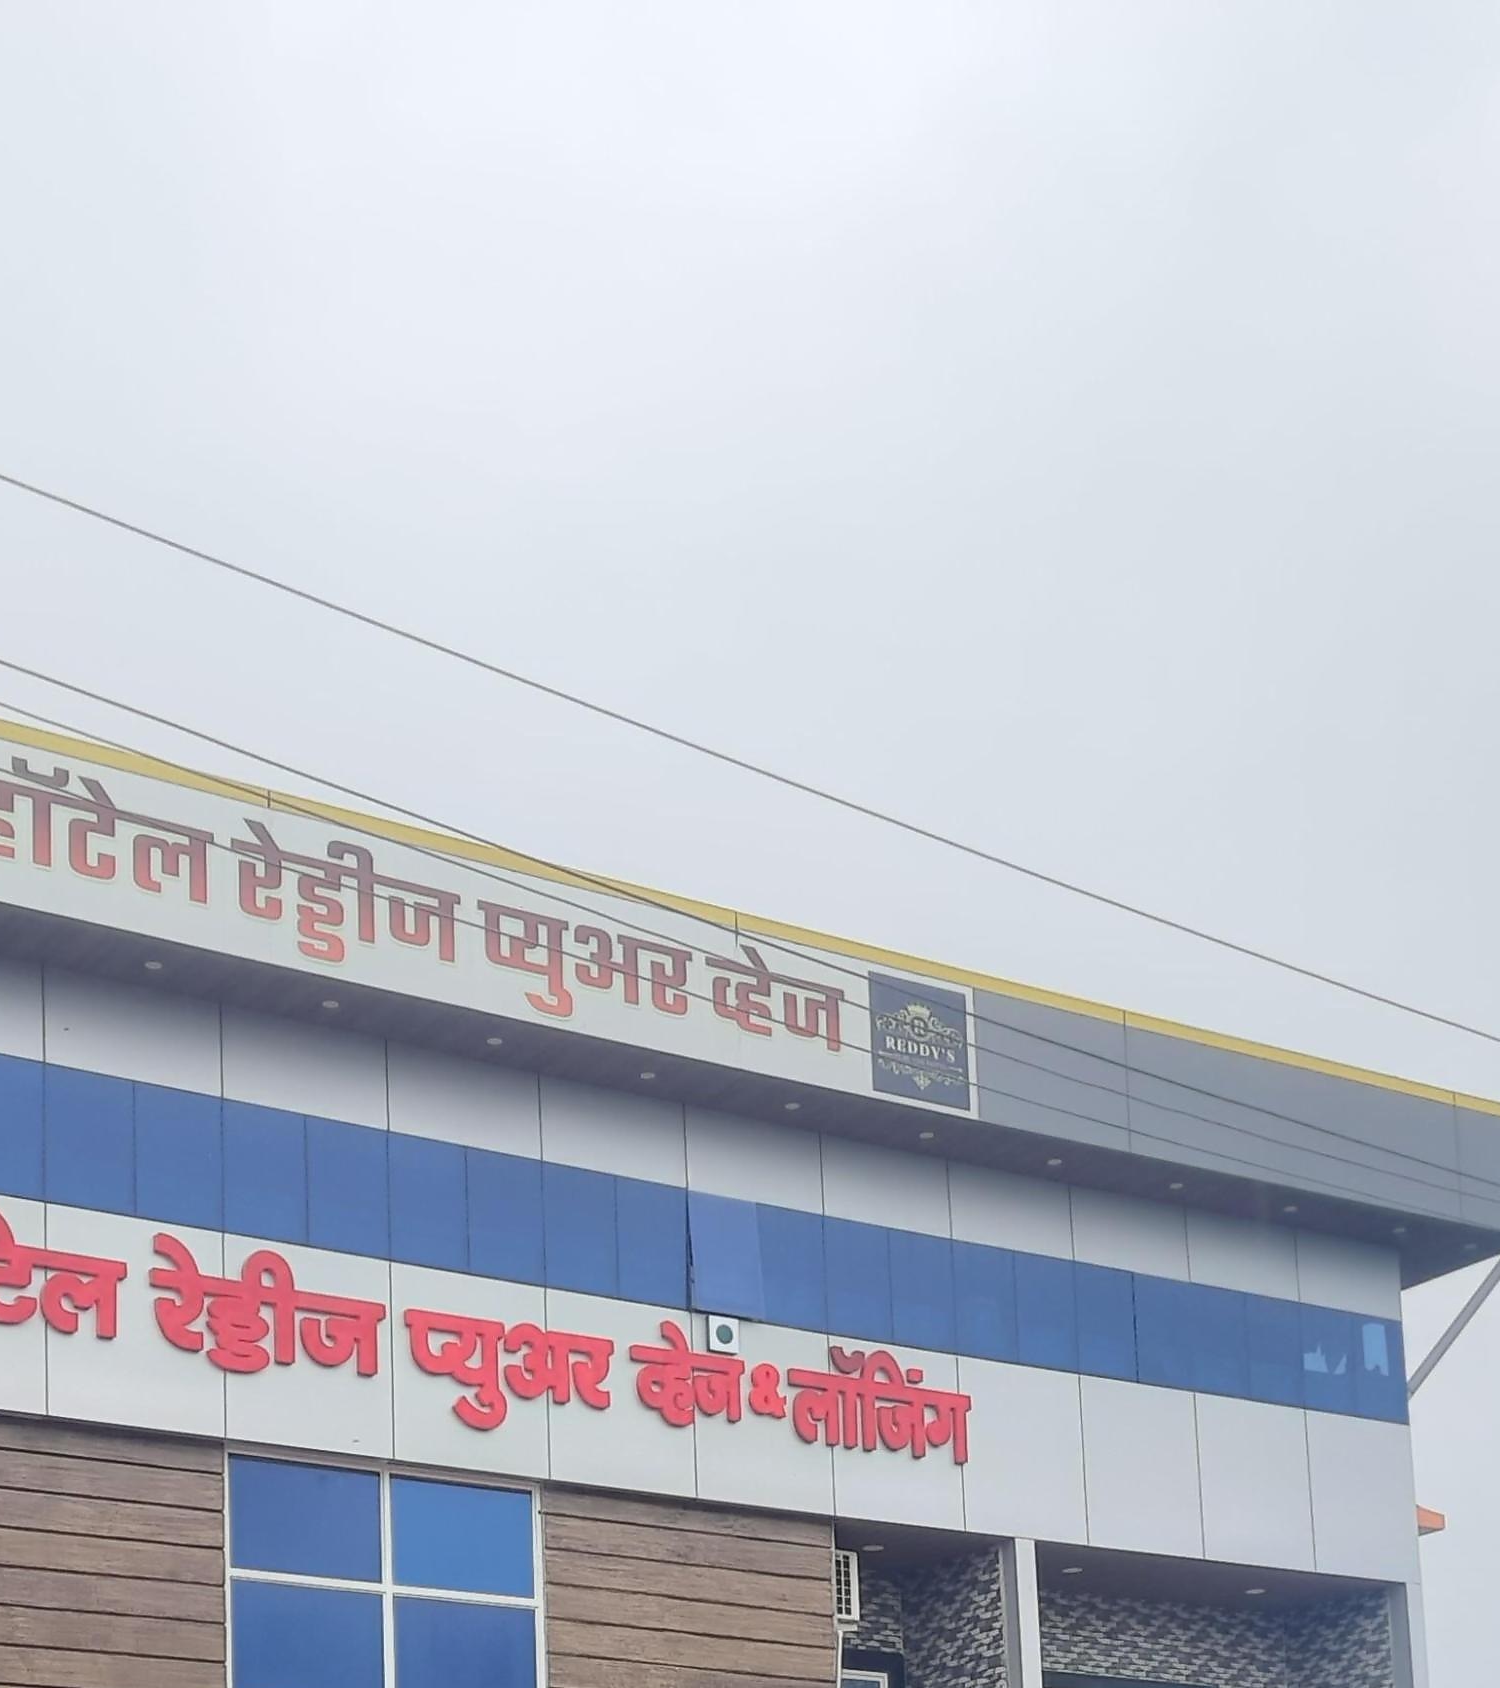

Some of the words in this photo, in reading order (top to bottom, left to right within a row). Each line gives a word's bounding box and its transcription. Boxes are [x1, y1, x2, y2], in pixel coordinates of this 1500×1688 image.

[231, 818, 461, 965] रेड्डीज
[885, 1036, 956, 1063] REDDY'S
[149, 1232, 386, 1377] रेड्डीज
